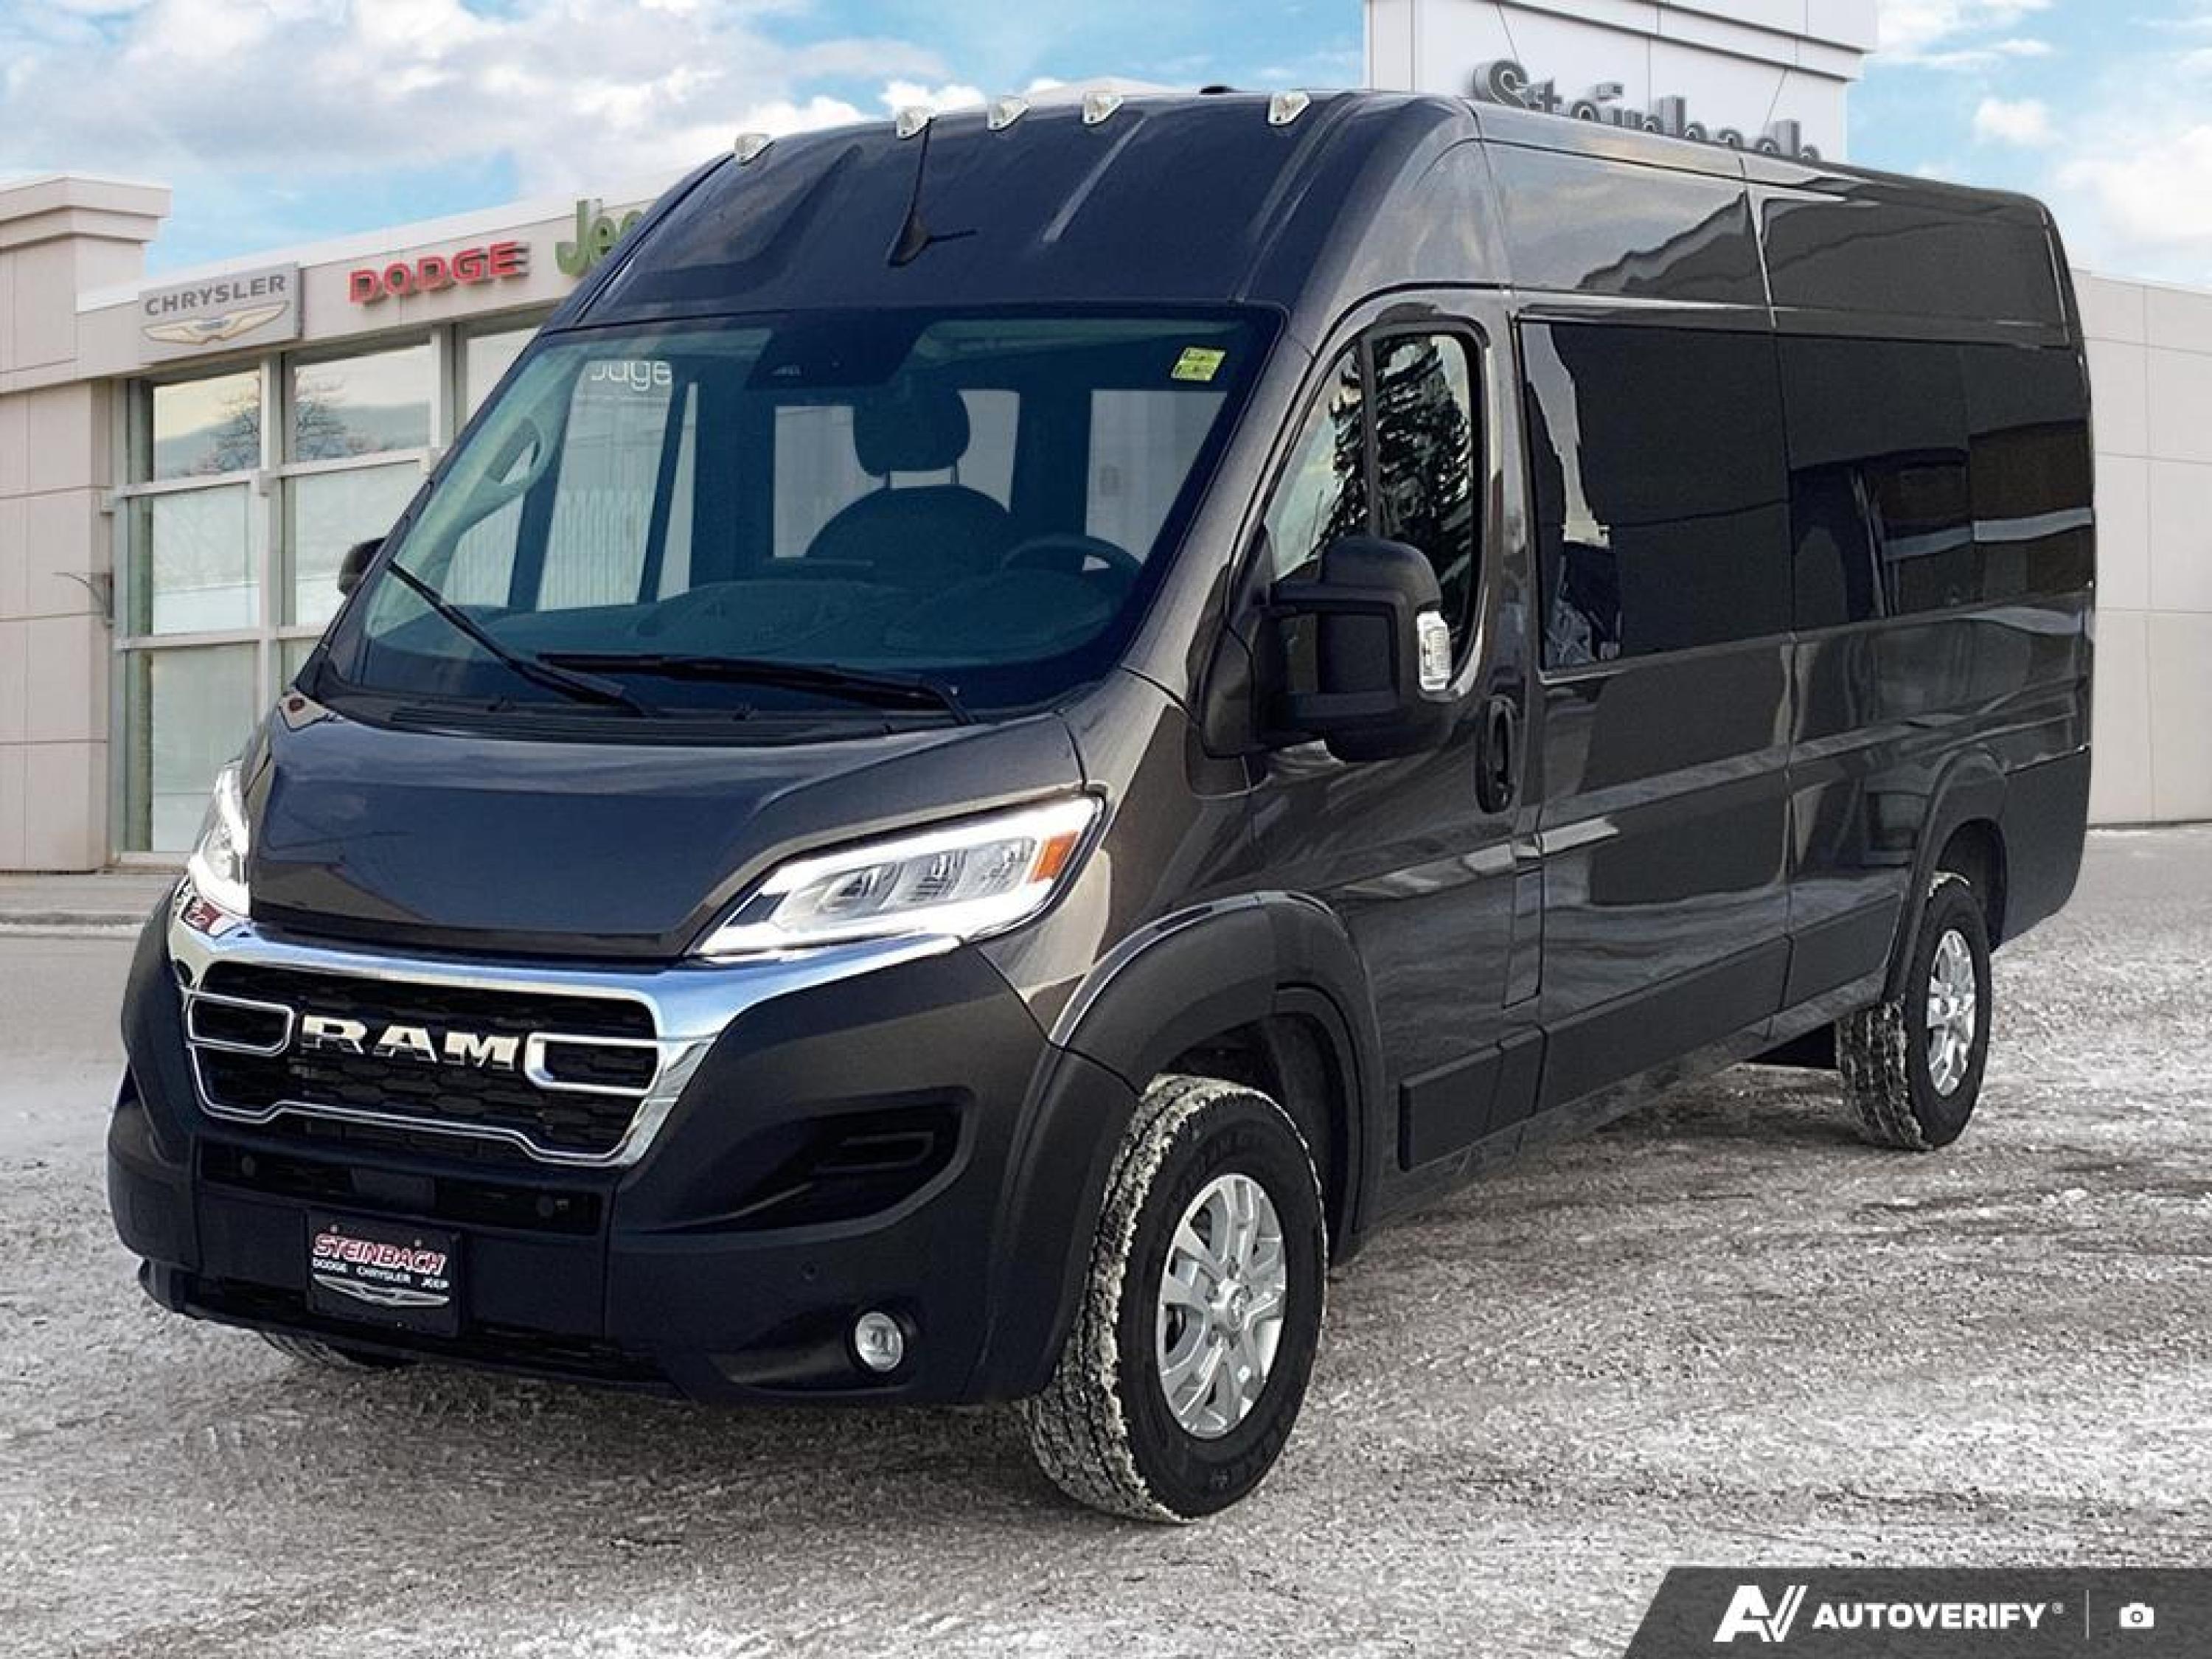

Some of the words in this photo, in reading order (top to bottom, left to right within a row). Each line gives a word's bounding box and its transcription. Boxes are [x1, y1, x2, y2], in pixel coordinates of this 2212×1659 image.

[555, 199, 643, 276] Je
[145, 274, 286, 316] CHRYSLER
[349, 241, 529, 304] DODGE
[302, 1015, 519, 1070] RAM
[313, 1233, 448, 1276] STEINBACH
